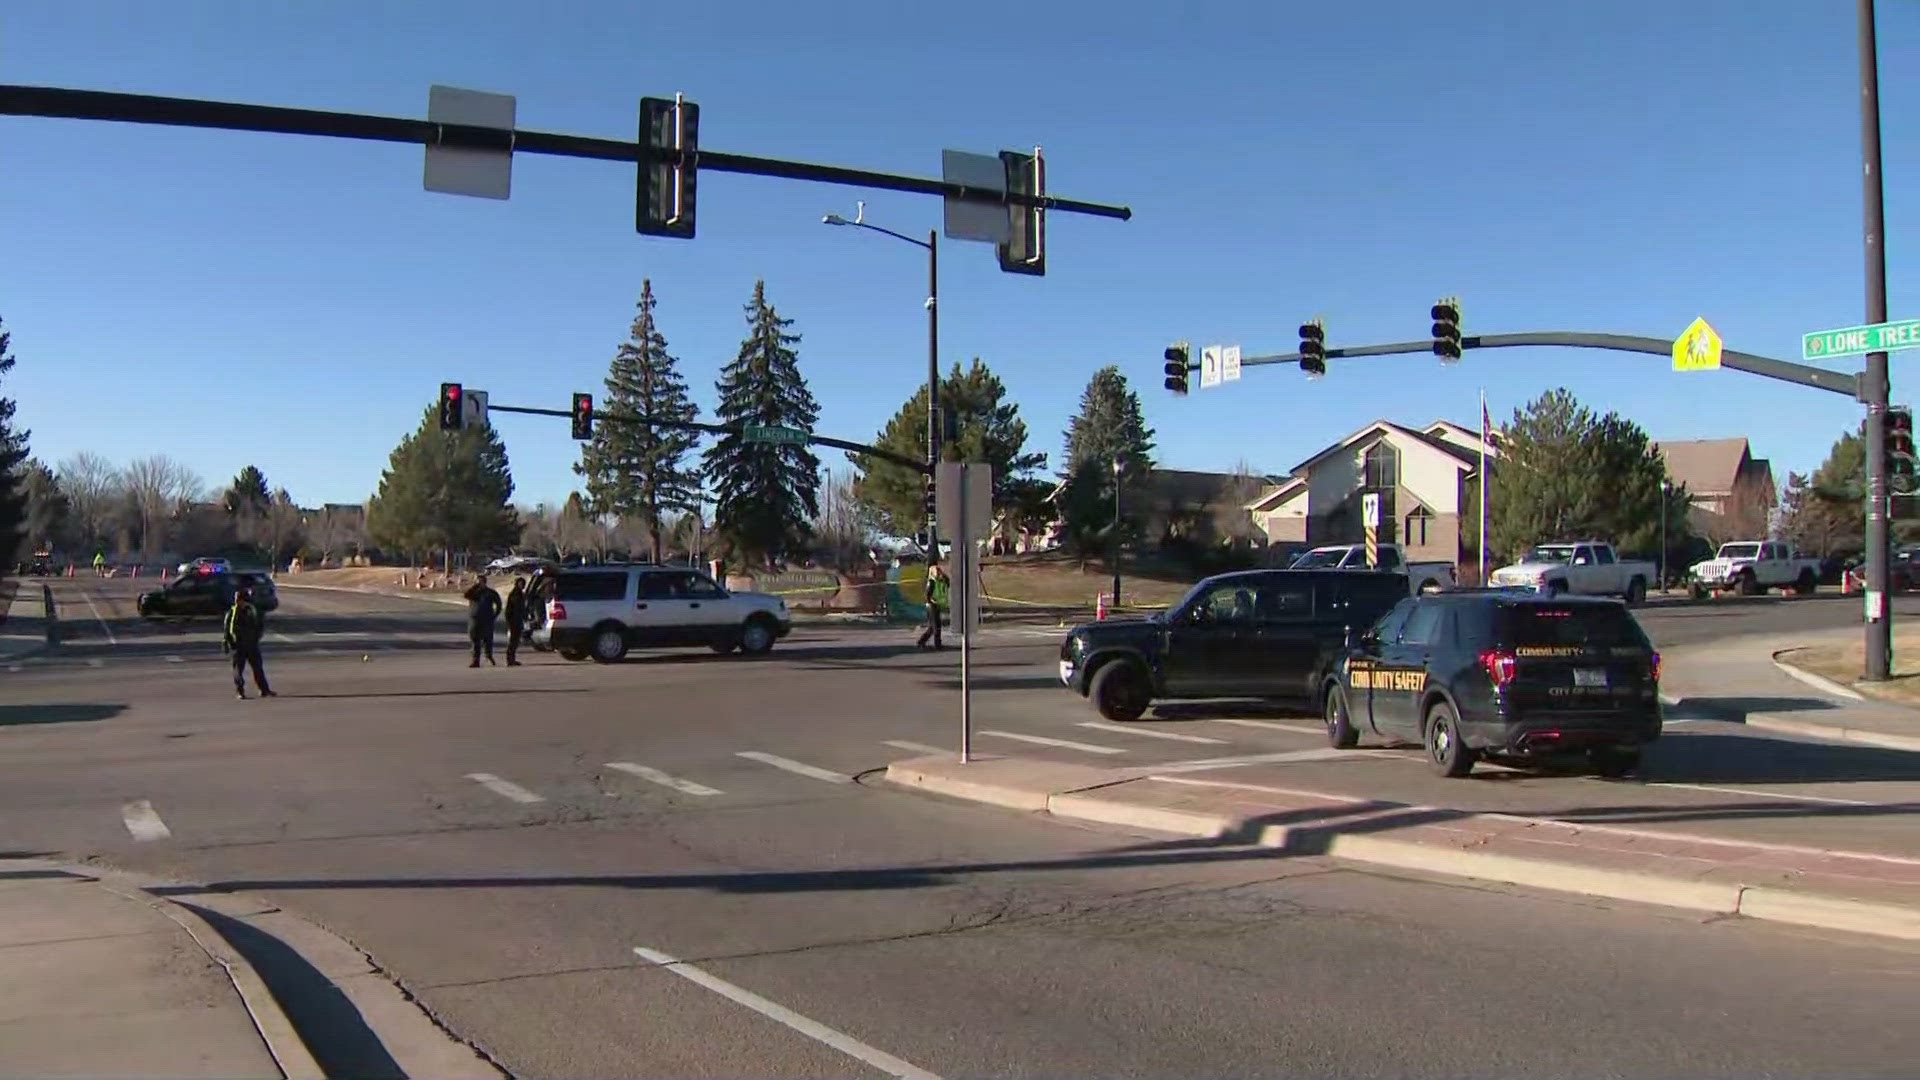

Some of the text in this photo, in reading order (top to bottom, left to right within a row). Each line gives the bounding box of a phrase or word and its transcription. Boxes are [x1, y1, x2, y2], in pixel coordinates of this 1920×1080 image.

[1826, 322, 1920, 353] LONE TREE
[1515, 646, 1580, 657] COMMUNITY
[1395, 671, 1428, 692] SAFETY
[1549, 686, 1570, 697] CITY
